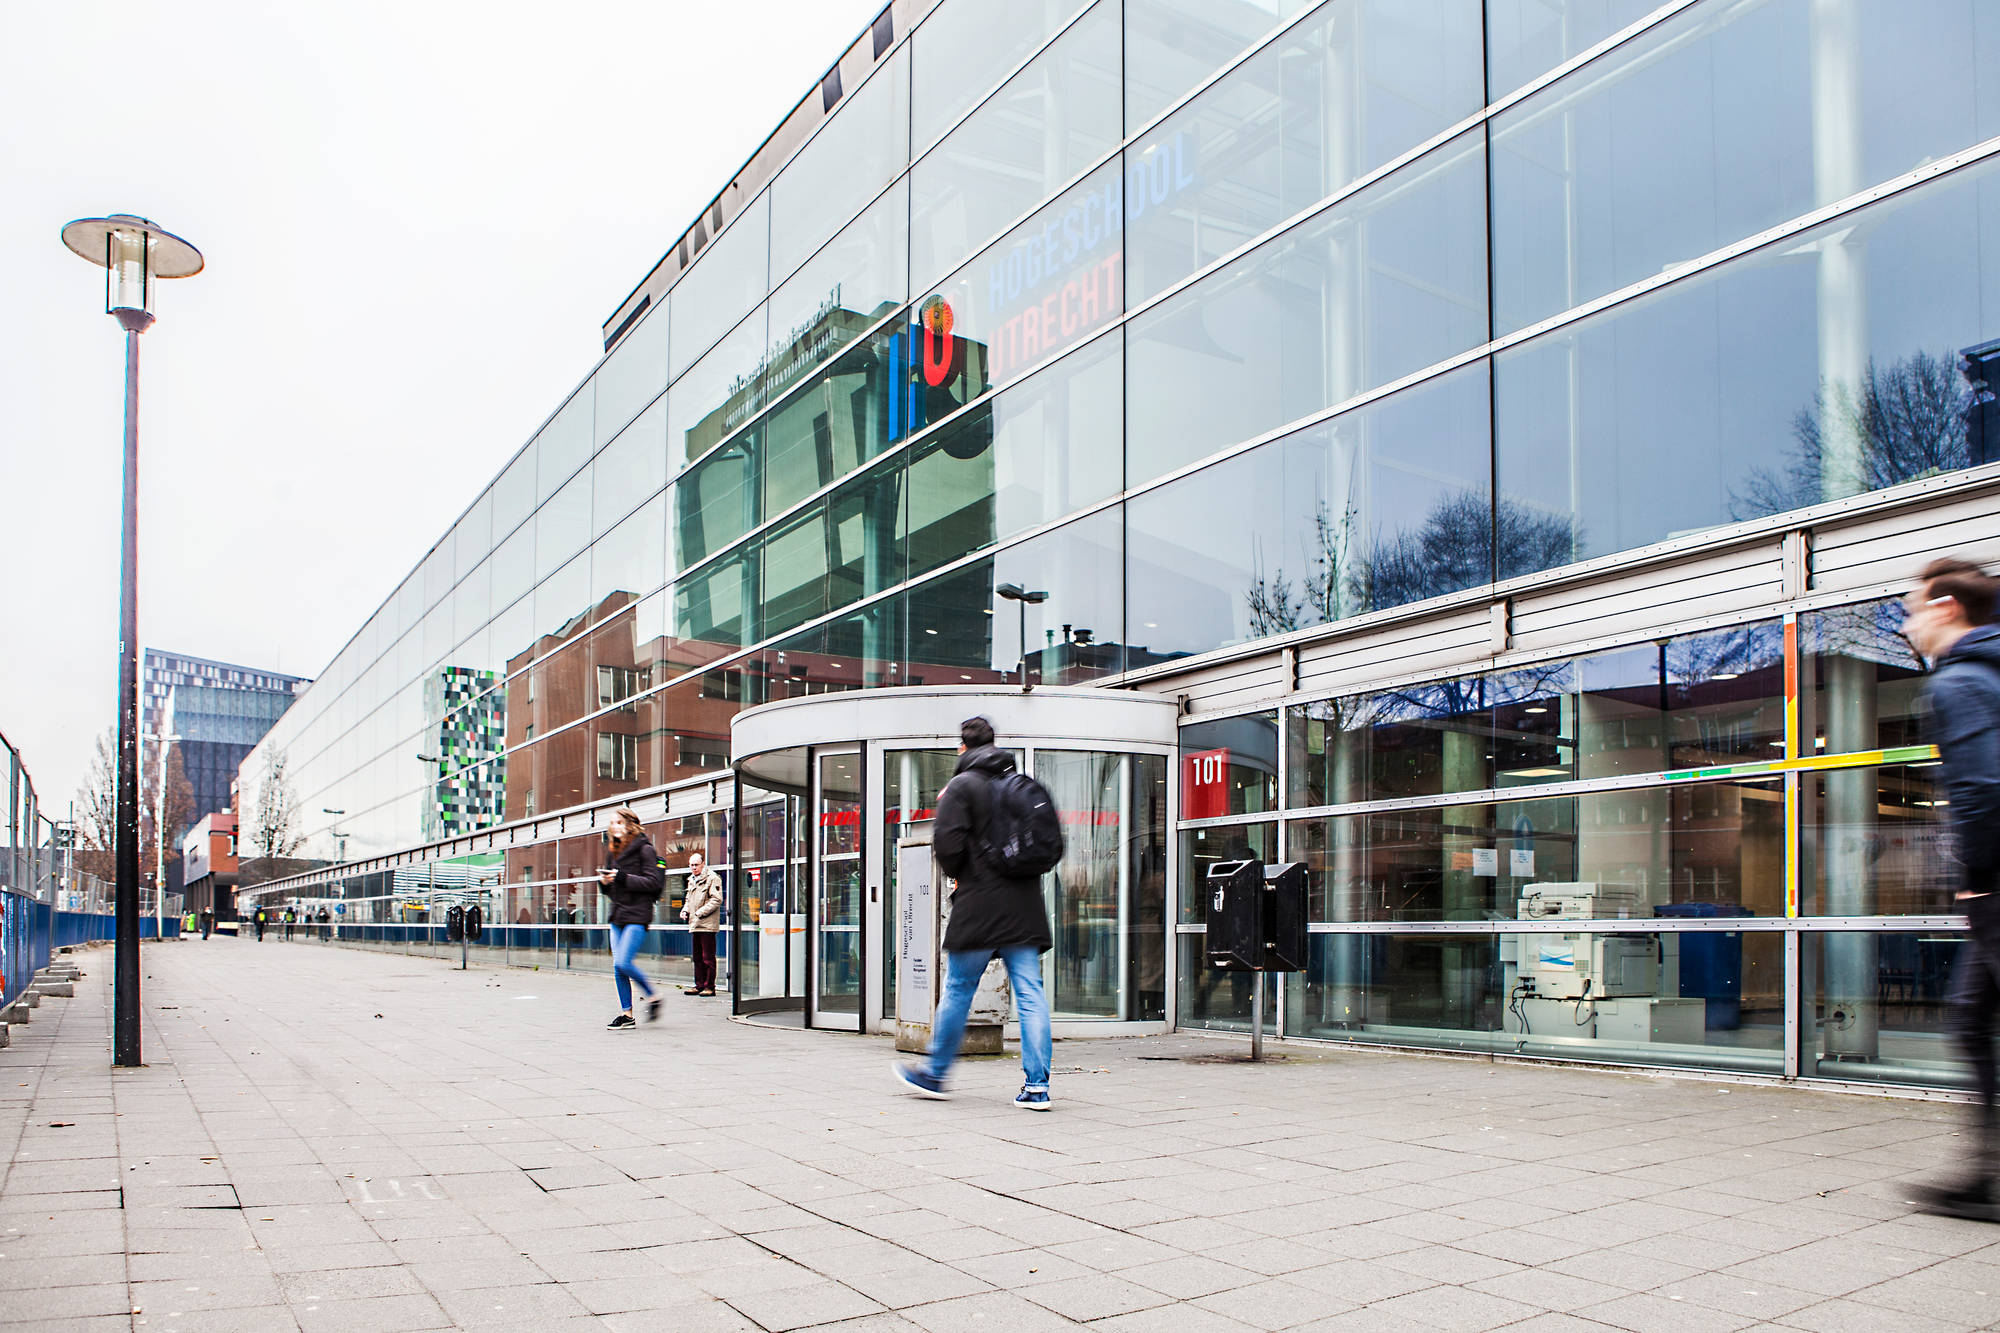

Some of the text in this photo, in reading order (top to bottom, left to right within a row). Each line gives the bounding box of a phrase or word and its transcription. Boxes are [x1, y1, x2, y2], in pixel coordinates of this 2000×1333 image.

[989, 131, 1194, 313] HOGESCHOOL
[988, 252, 1122, 380] UTRECHT
[1193, 755, 1222, 786] 101
